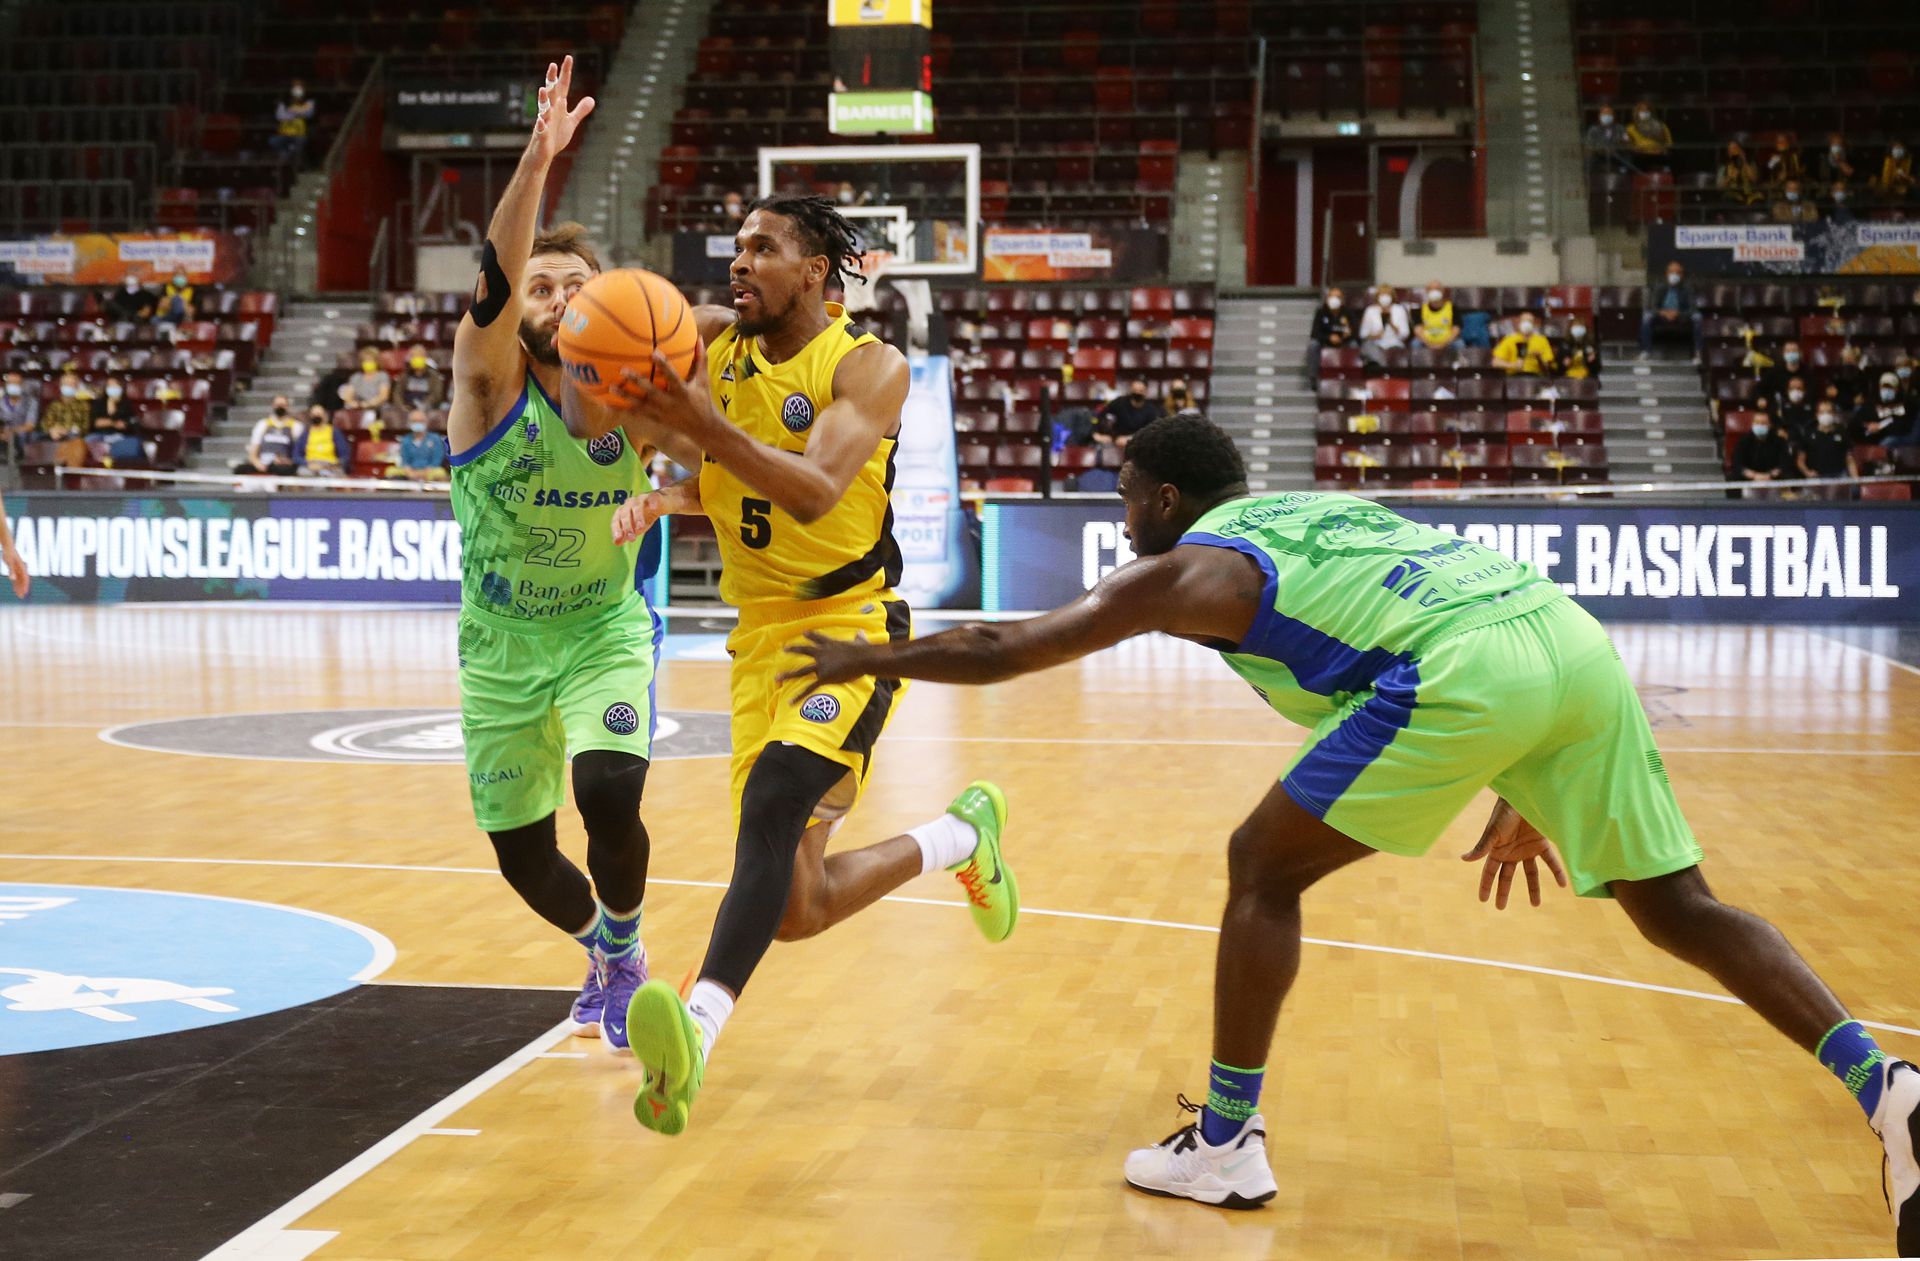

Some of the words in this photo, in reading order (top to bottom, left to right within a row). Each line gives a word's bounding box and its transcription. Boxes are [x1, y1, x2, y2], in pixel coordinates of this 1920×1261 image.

[837, 106, 913, 120] BARMER
[1679, 229, 1788, 245] Sparda-Bank
[1860, 229, 1920, 243] Sparda
[740, 496, 772, 550] 5
[893, 528, 942, 542] PORT
[525, 527, 586, 568] 22
[1433, 547, 1480, 568] MUT
[1456, 560, 1522, 587] ACRISU
[470, 765, 523, 785] TISCALI
